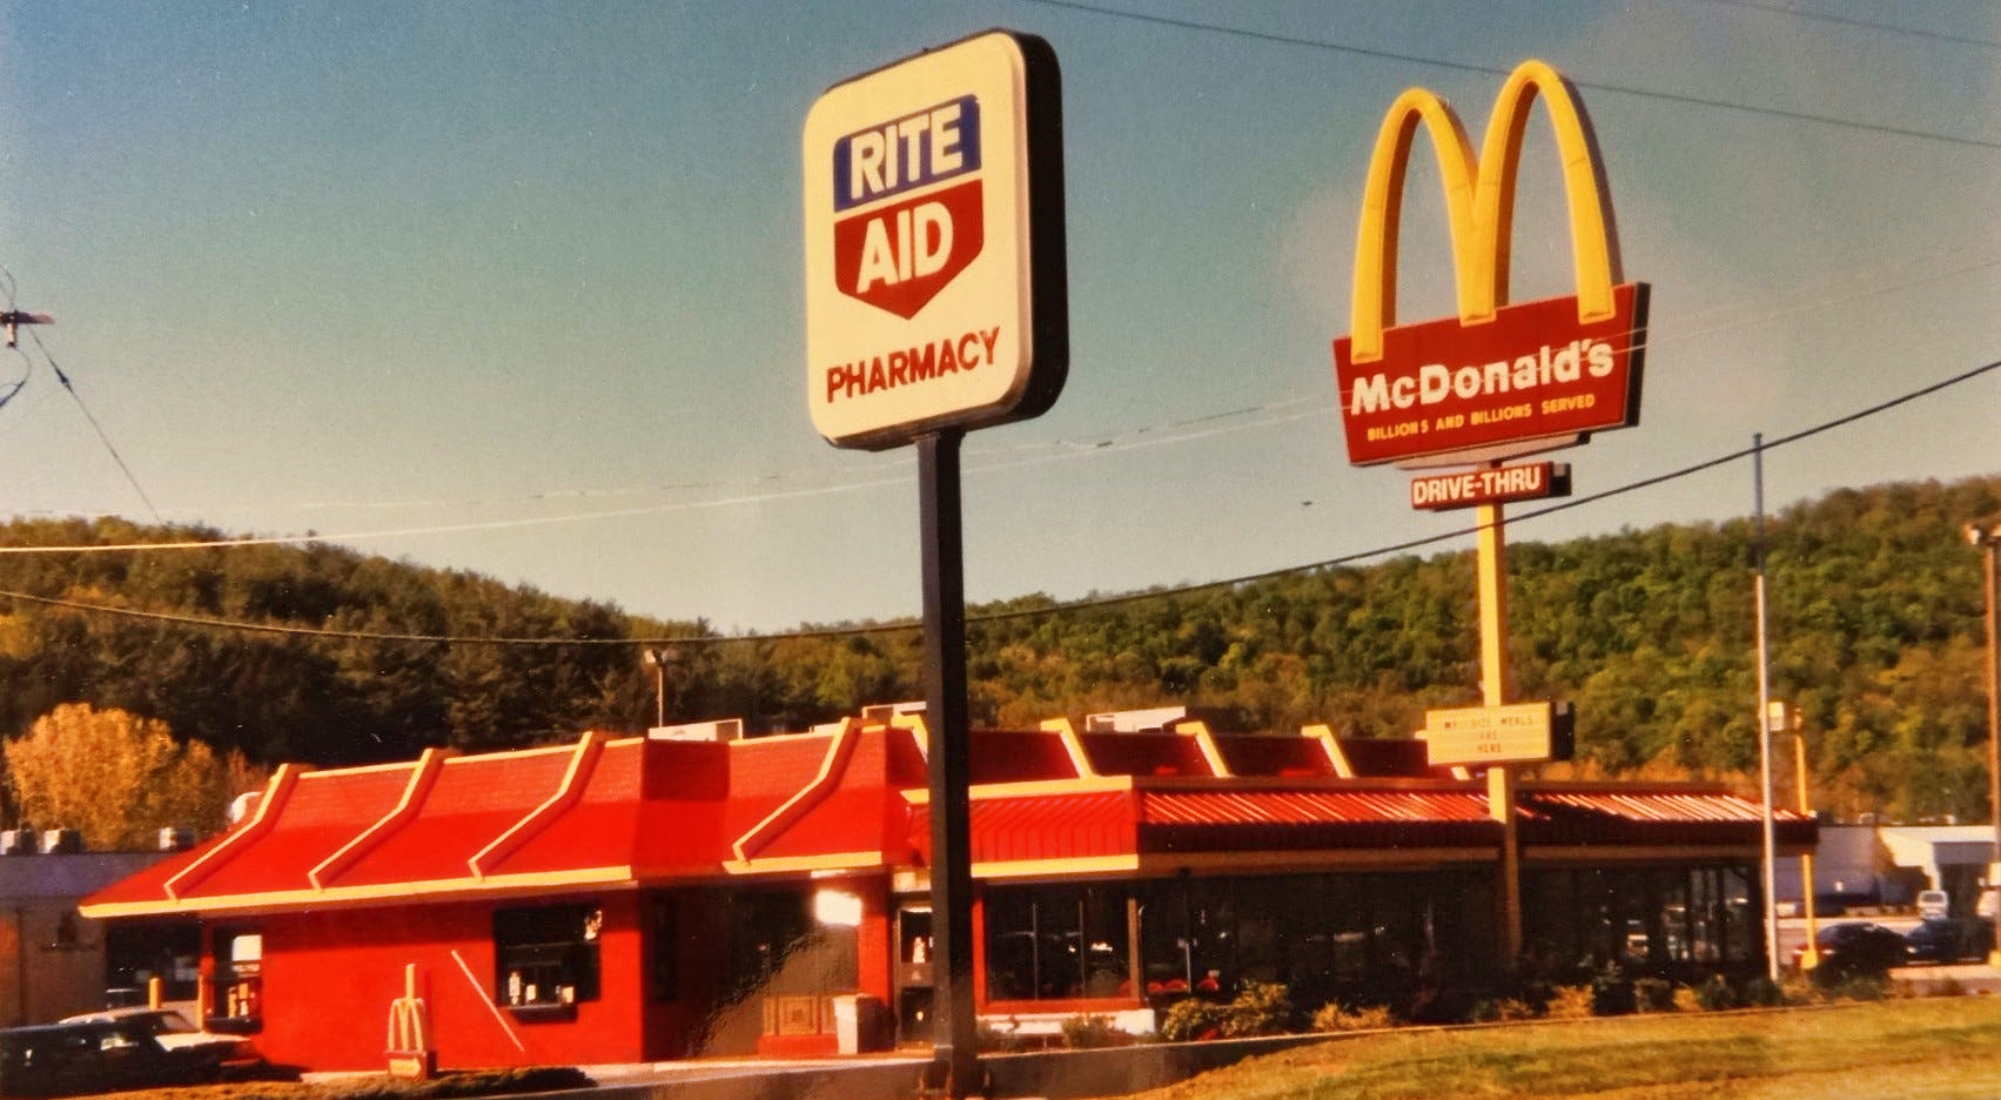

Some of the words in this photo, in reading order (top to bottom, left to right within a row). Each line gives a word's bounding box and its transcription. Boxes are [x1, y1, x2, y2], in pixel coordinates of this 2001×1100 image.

[850, 103, 962, 200] RITE
[856, 201, 954, 294] AID
[827, 326, 1000, 403] PHARMACY
[1351, 338, 1614, 415] McDonald's
[1367, 419, 1429, 442] BILLIONS
[1436, 414, 1465, 431] AND
[1471, 403, 1532, 426] BILLIONS
[1542, 393, 1596, 414] SERVED
[1413, 466, 1541, 504] DRIVE-THRU
